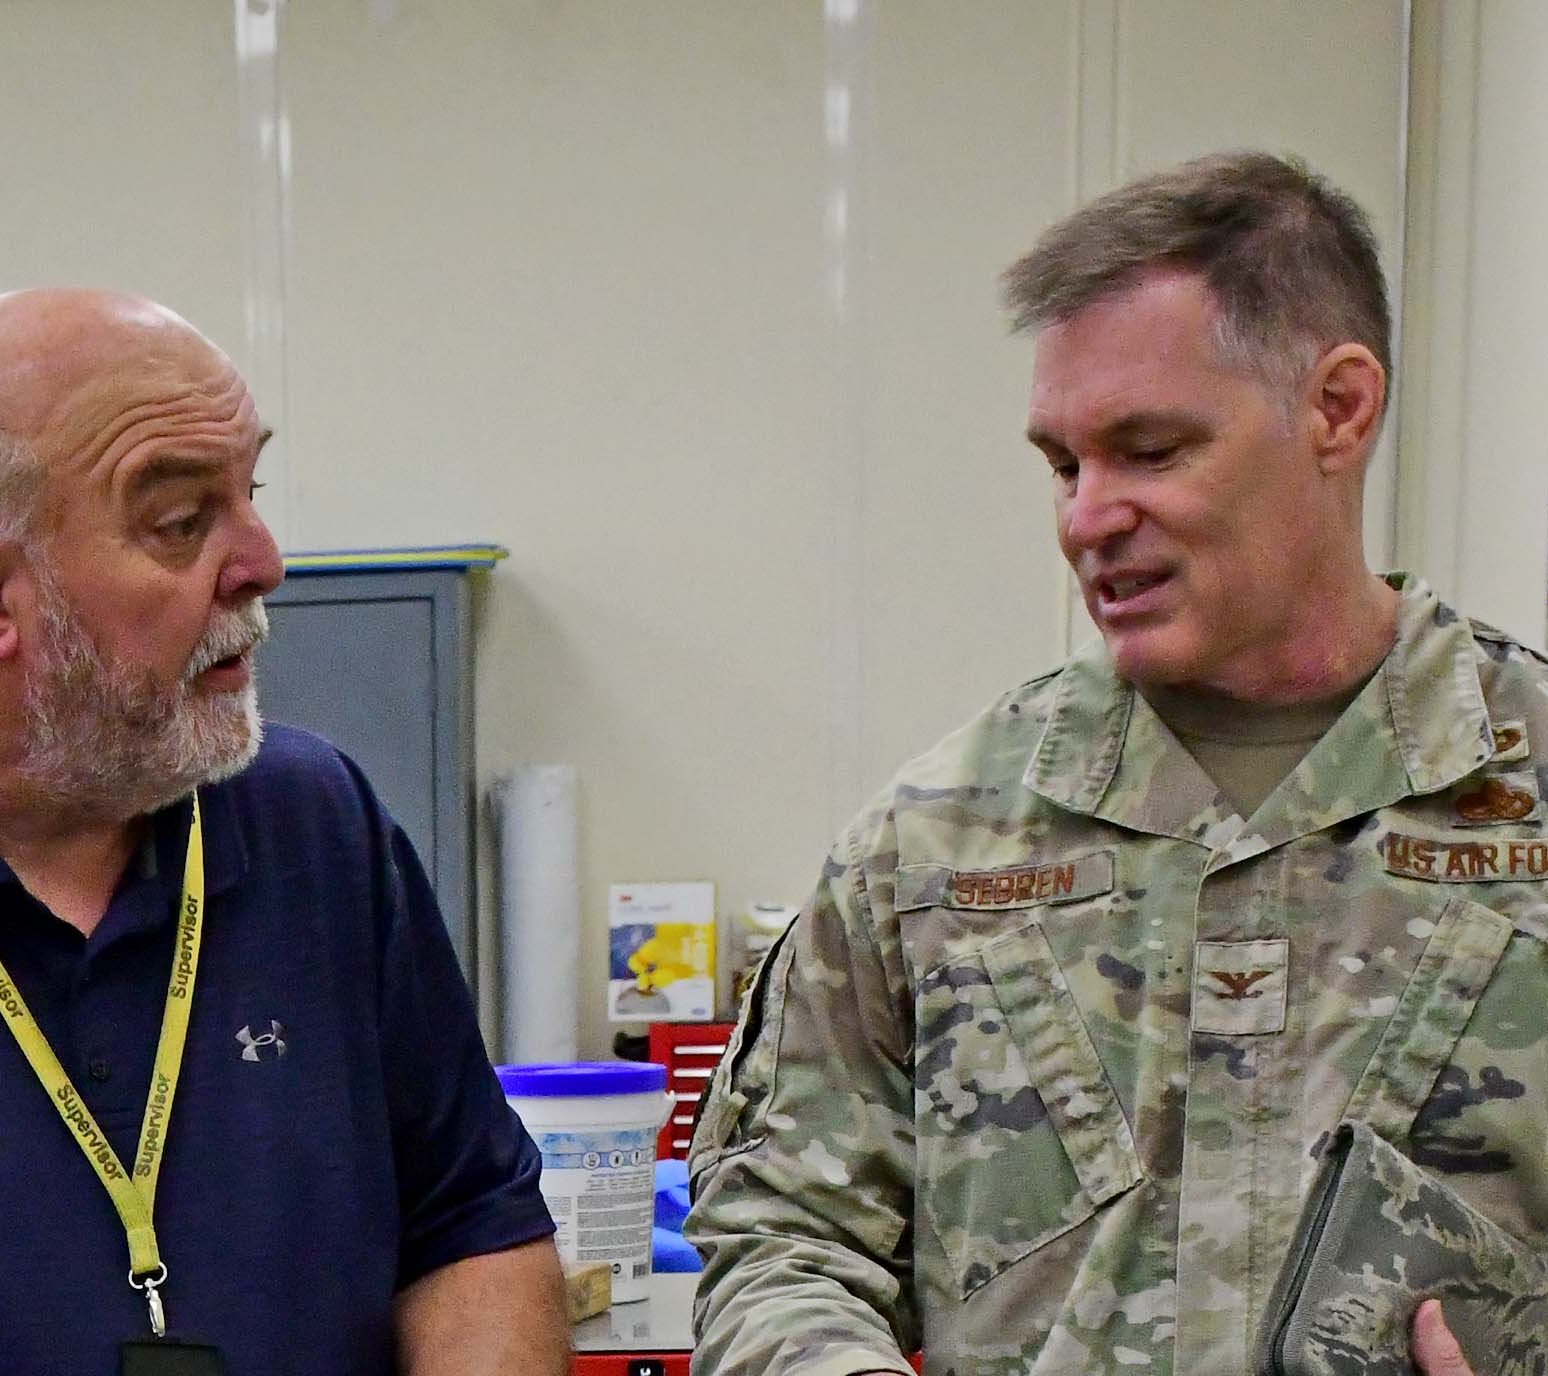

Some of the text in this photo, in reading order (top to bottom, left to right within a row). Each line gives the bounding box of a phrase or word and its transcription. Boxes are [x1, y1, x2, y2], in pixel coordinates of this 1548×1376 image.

[1389, 833, 1436, 876] US
[1446, 842, 1499, 877] AIR
[170, 894, 200, 1000] Supervisor
[57, 1084, 124, 1183] Supervisor
[135, 1071, 172, 1178] Supervisor
